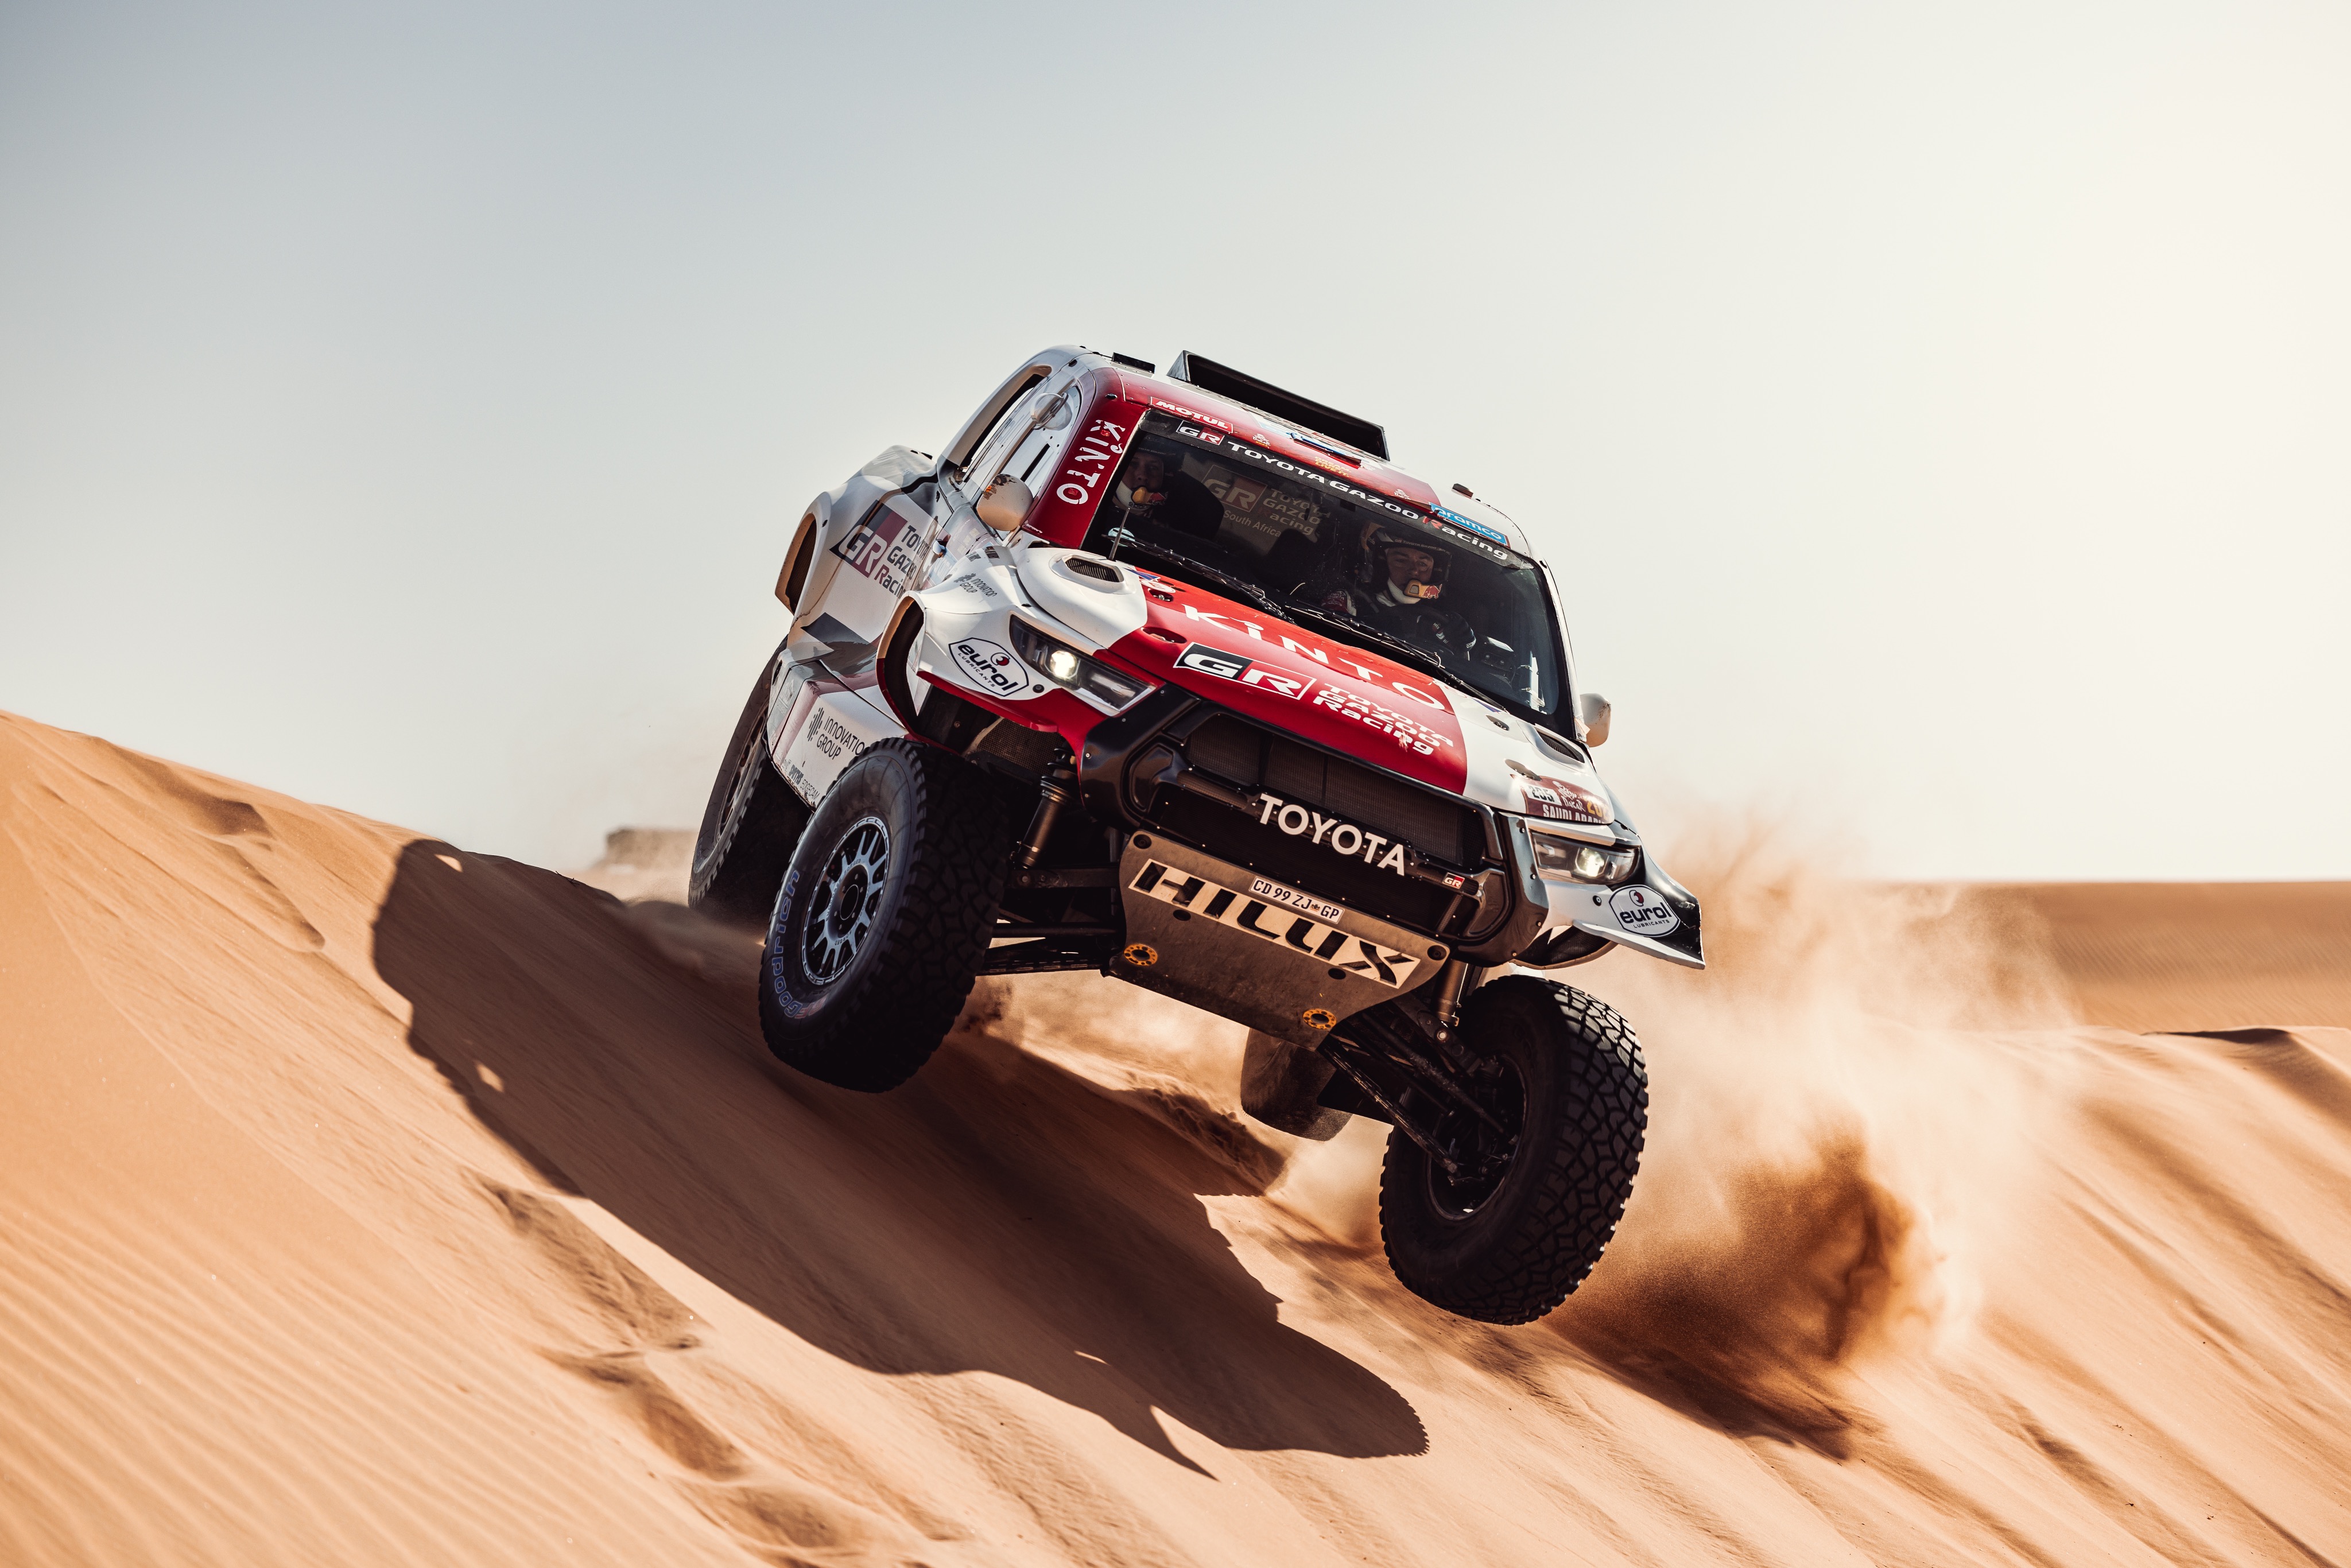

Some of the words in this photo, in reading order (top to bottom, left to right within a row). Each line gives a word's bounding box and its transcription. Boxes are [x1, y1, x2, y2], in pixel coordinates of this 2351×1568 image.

[1155, 401, 1228, 429] MOTUL
[1179, 426, 1220, 444] GR
[1228, 441, 1325, 483] TOYOTA
[1329, 480, 1419, 519] GAZOO
[1204, 479, 1256, 509] GR
[1224, 510, 1251, 526] South
[1252, 521, 1282, 537] Africa
[1430, 506, 1502, 540] aramco
[838, 525, 887, 574] GR
[887, 545, 917, 580] GAZOO
[957, 644, 1019, 691] eurol
[957, 653, 996, 688] LUBRICANTS
[1184, 653, 1302, 696] GR
[1312, 696, 1434, 755] Racing
[1318, 690, 1441, 747] GAZOO
[1324, 683, 1454, 747] TOYOTA
[816, 733, 841, 760] GROUP
[1561, 795, 1586, 812] DAKAR
[1259, 793, 1405, 876] TOYOTA
[1253, 880, 1273, 895] CD
[1273, 887, 1291, 901] 99
[1291, 894, 1313, 910] ZJ
[1320, 905, 1340, 919] GP
[1444, 877, 1462, 887] GR
[1134, 861, 1415, 986] HILUX
[1619, 902, 1673, 924] eurol
[1633, 919, 1670, 929] LUBRICANTS
